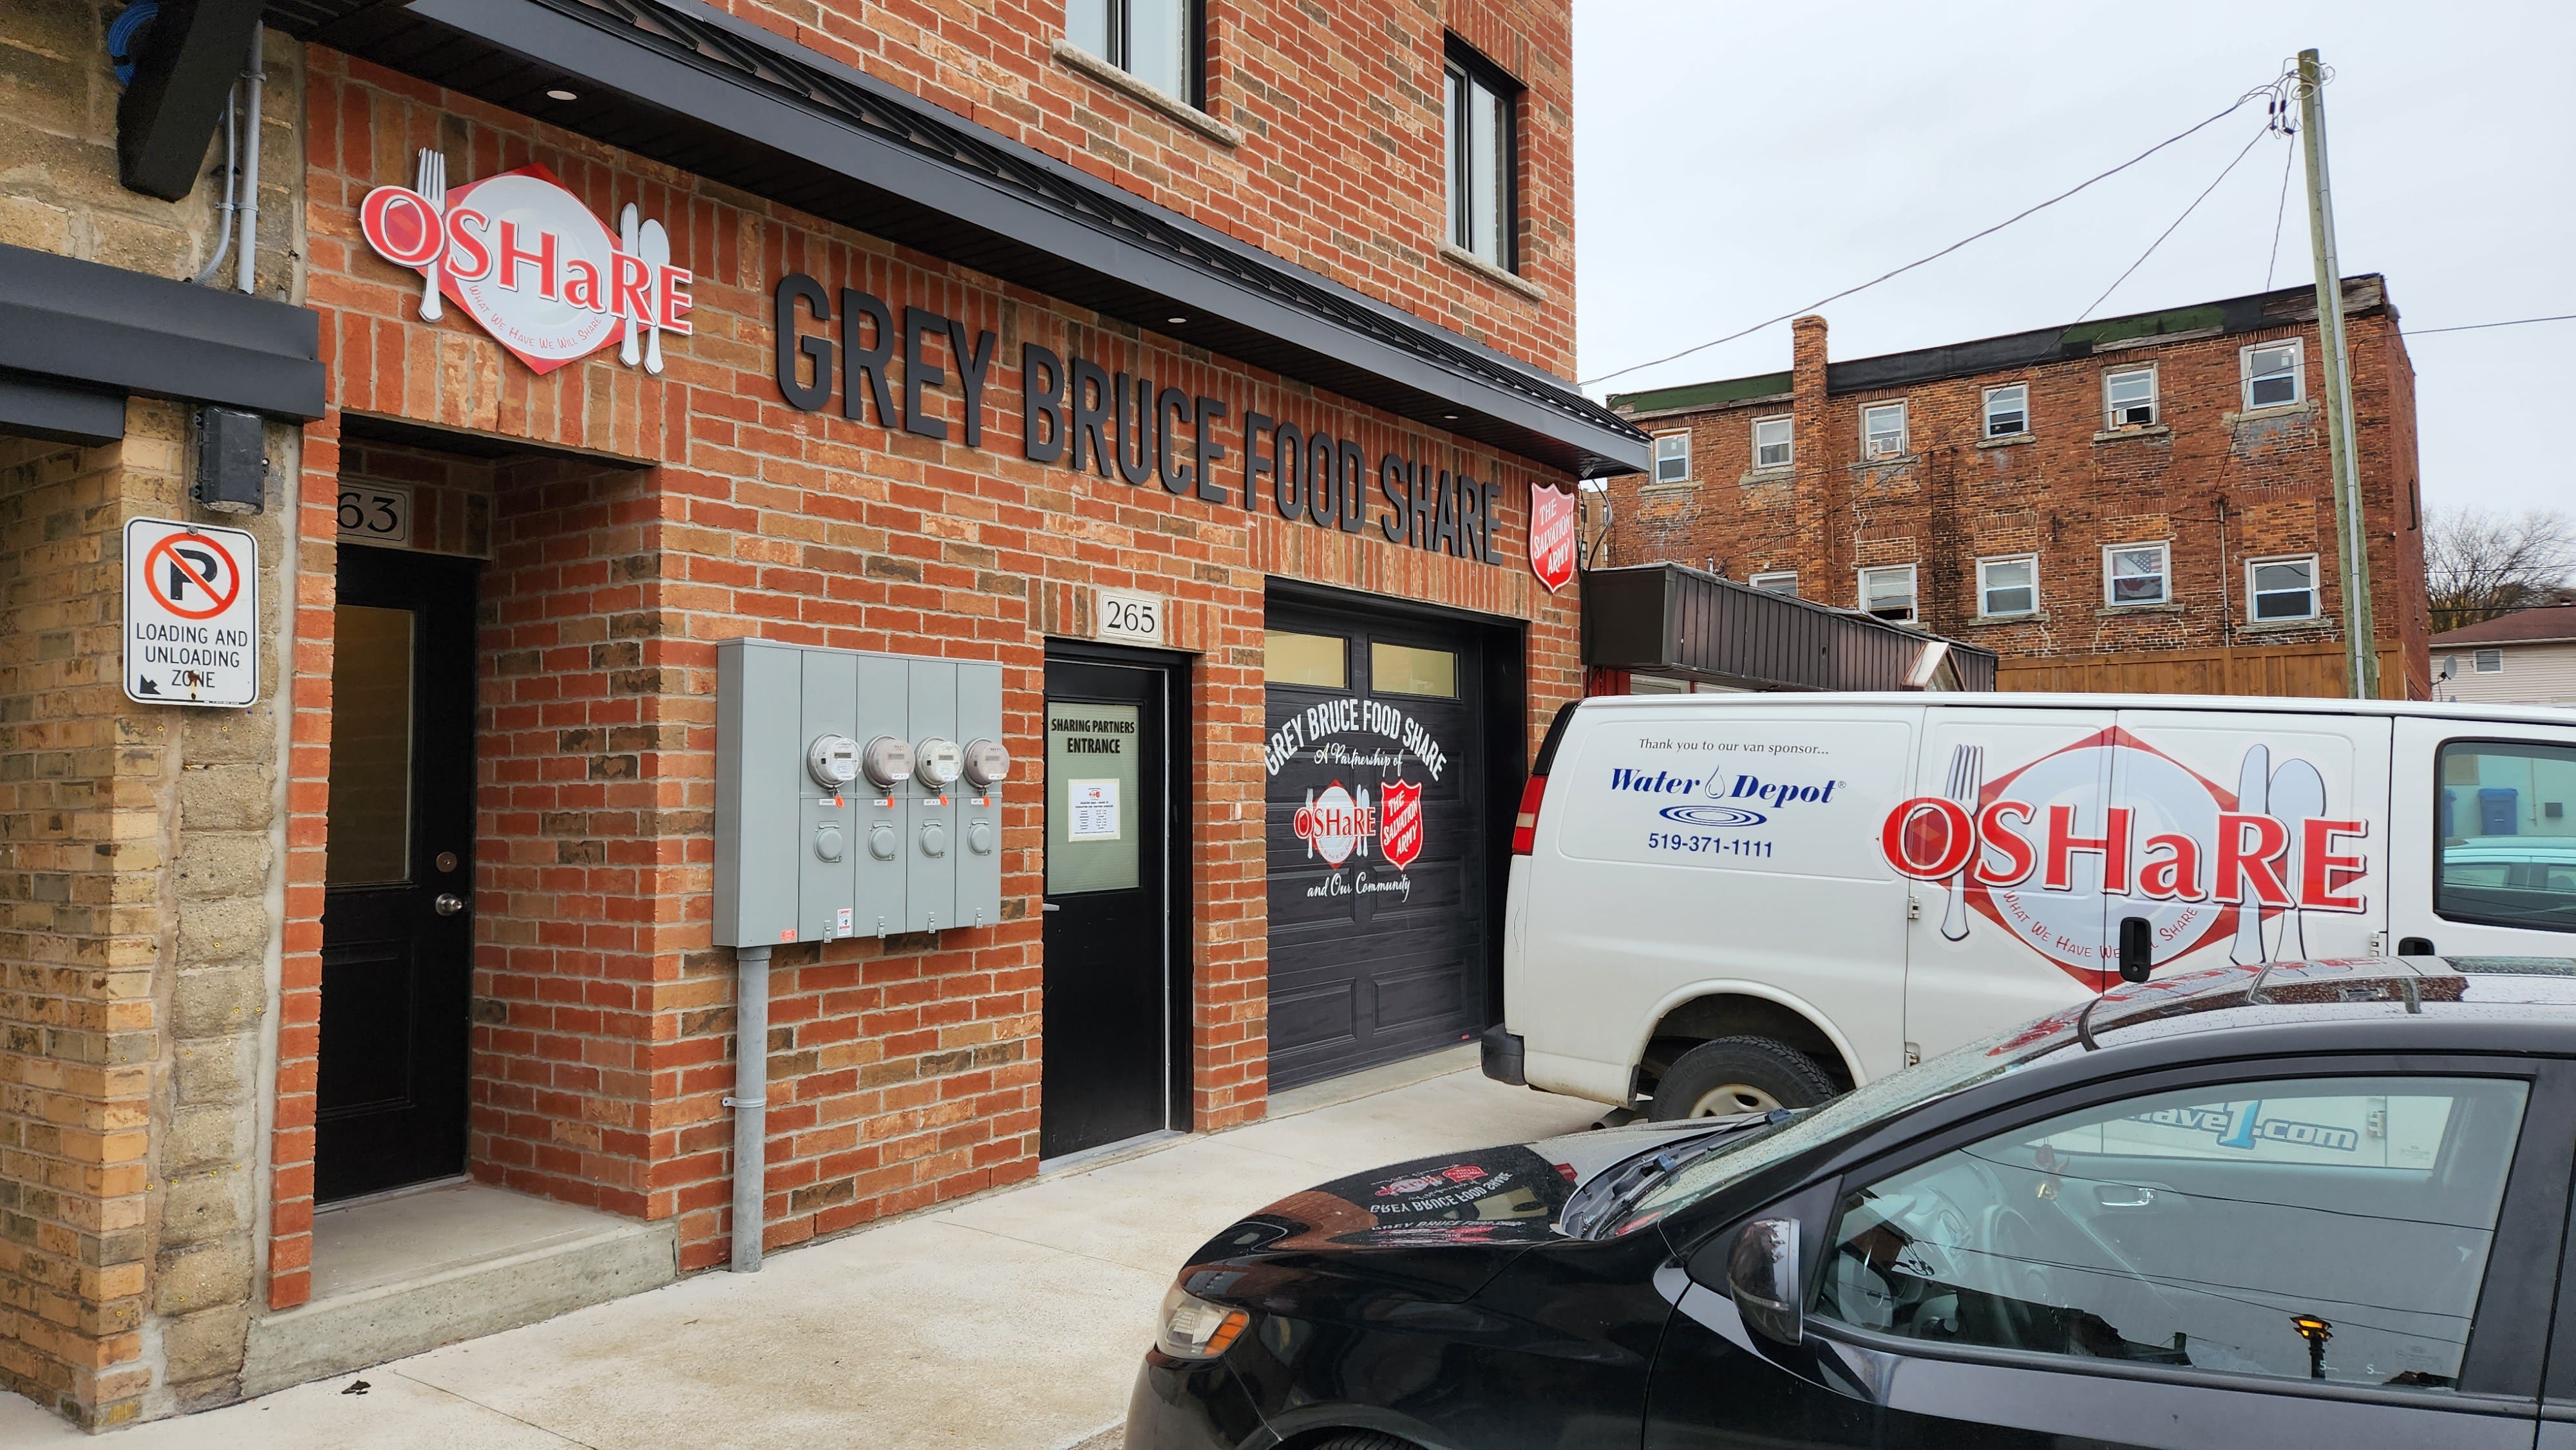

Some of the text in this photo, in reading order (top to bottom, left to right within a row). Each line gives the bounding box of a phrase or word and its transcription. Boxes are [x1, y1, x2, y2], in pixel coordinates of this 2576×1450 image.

[362, 185, 693, 335] OSHaRE
[469, 285, 601, 349] WHAT WE HAVE WE WILL SHARE
[777, 273, 1502, 565] GREY BRUCE FOOD SHARE
[1540, 498, 1557, 526] THE
[1534, 510, 1571, 559] SALVATION
[1547, 538, 1570, 577] ARMY
[1107, 601, 1155, 633] 265
[137, 623, 248, 647] LOADING AND
[146, 646, 240, 668] UNLOADING
[1051, 718, 1135, 734] SHARING PARTNERS
[1265, 699, 1447, 782] GREY BRUCE FOOD SHARE
[1067, 737, 1121, 754] ENTRANCE
[1314, 742, 1404, 777] A Partnership of
[1639, 739, 1829, 756] Thank you to our van sponsor...
[1611, 768, 1700, 794] Water
[1388, 790, 1405, 816] THE
[1294, 807, 1376, 840] OSHaRE
[1384, 799, 1419, 846] SALVATION
[1396, 821, 1418, 858] ARMY
[1648, 833, 1773, 858] 519-371-1111
[1880, 795, 2368, 914] OSHaRE
[1307, 871, 1410, 903] and Our Community
[2003, 890, 2197, 959] WHAT WE HAVE WE SHARE
